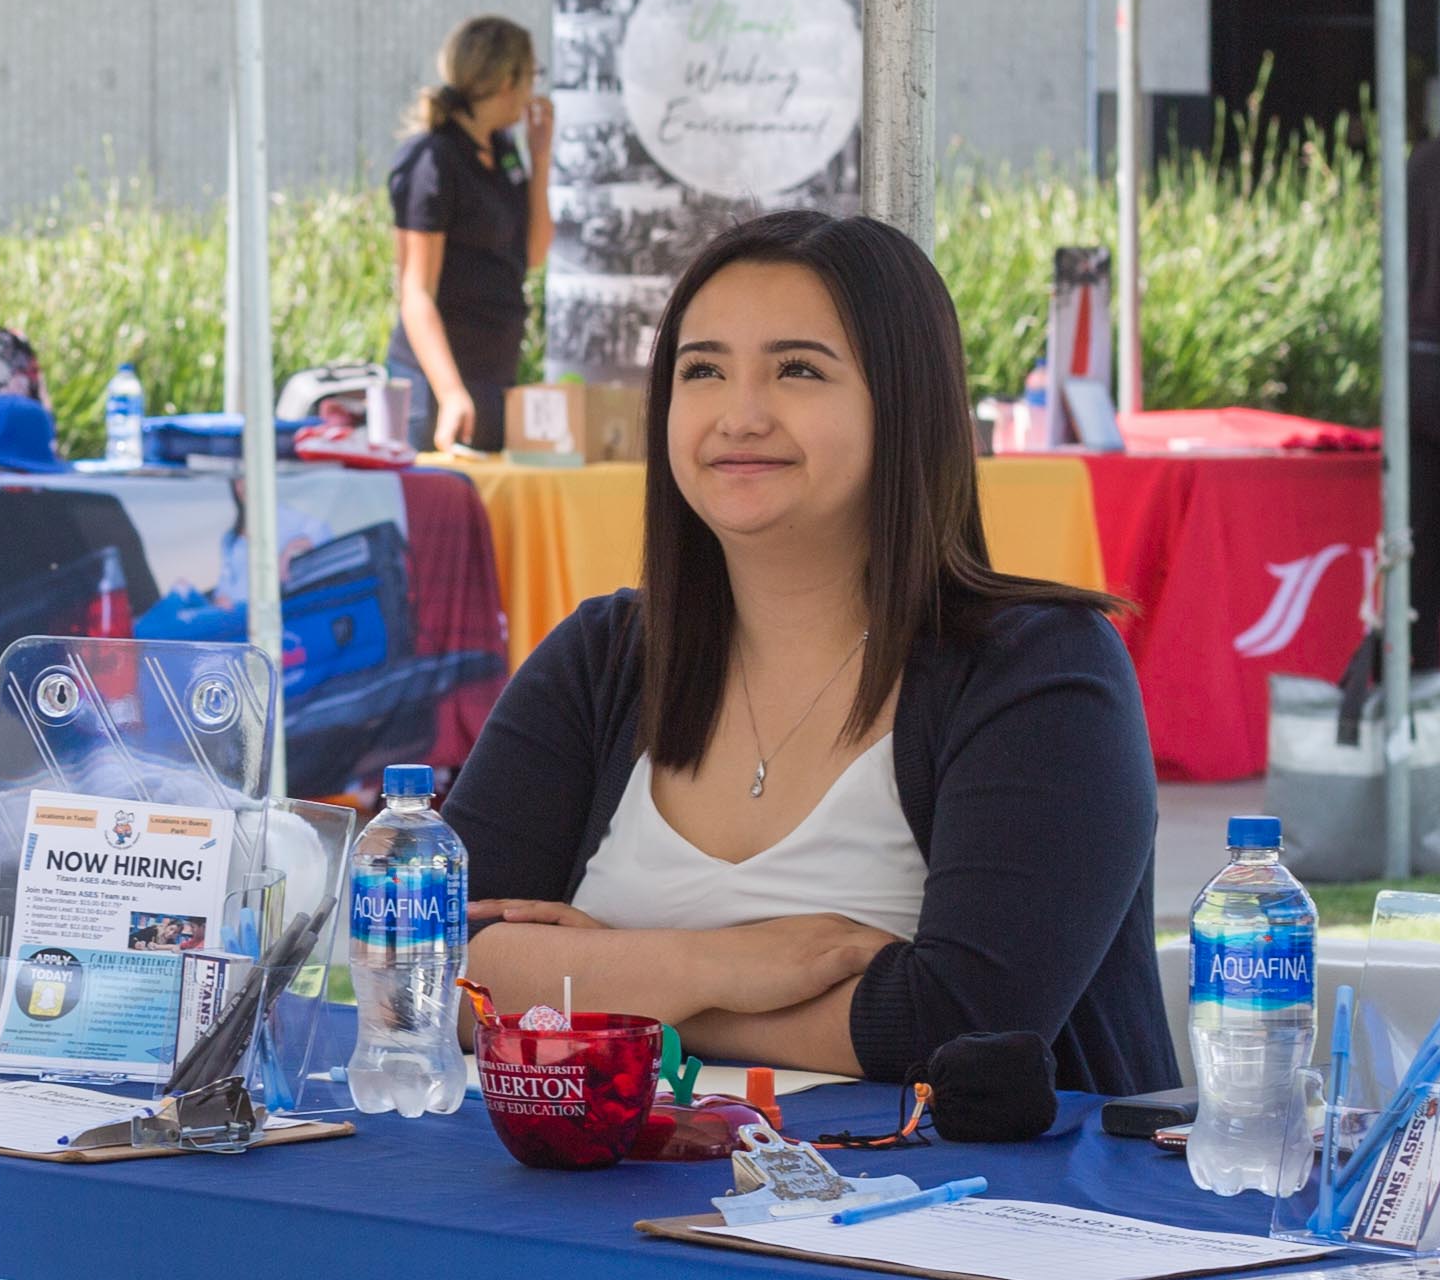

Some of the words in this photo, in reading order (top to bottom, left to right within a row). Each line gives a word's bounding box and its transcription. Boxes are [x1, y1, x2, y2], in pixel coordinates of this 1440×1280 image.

[47, 850, 109, 874] NOW
[114, 855, 203, 882] HIRING!
[56, 875, 77, 883] Titans
[79, 876, 100, 885] ASES
[147, 882, 182, 892] Programs
[25, 886, 40, 894] Join
[55, 889, 76, 897] Titans
[78, 890, 99, 898] ASES
[101, 892, 120, 900] Team
[353, 893, 445, 923] AQUAFINA
[31, 968, 73, 983] TODAY!
[1209, 953, 1310, 984] AQUAFINA
[200, 963, 216, 1026] TITANS
[496, 1062, 521, 1073] STATE
[522, 1064, 586, 1075] UNIVERSITY
[507, 1102, 586, 1116] EDUCATION
[1371, 1170, 1407, 1237] TITANS
[1399, 1117, 1426, 1167] ASES
[993, 1205, 1061, 1219] Titans
